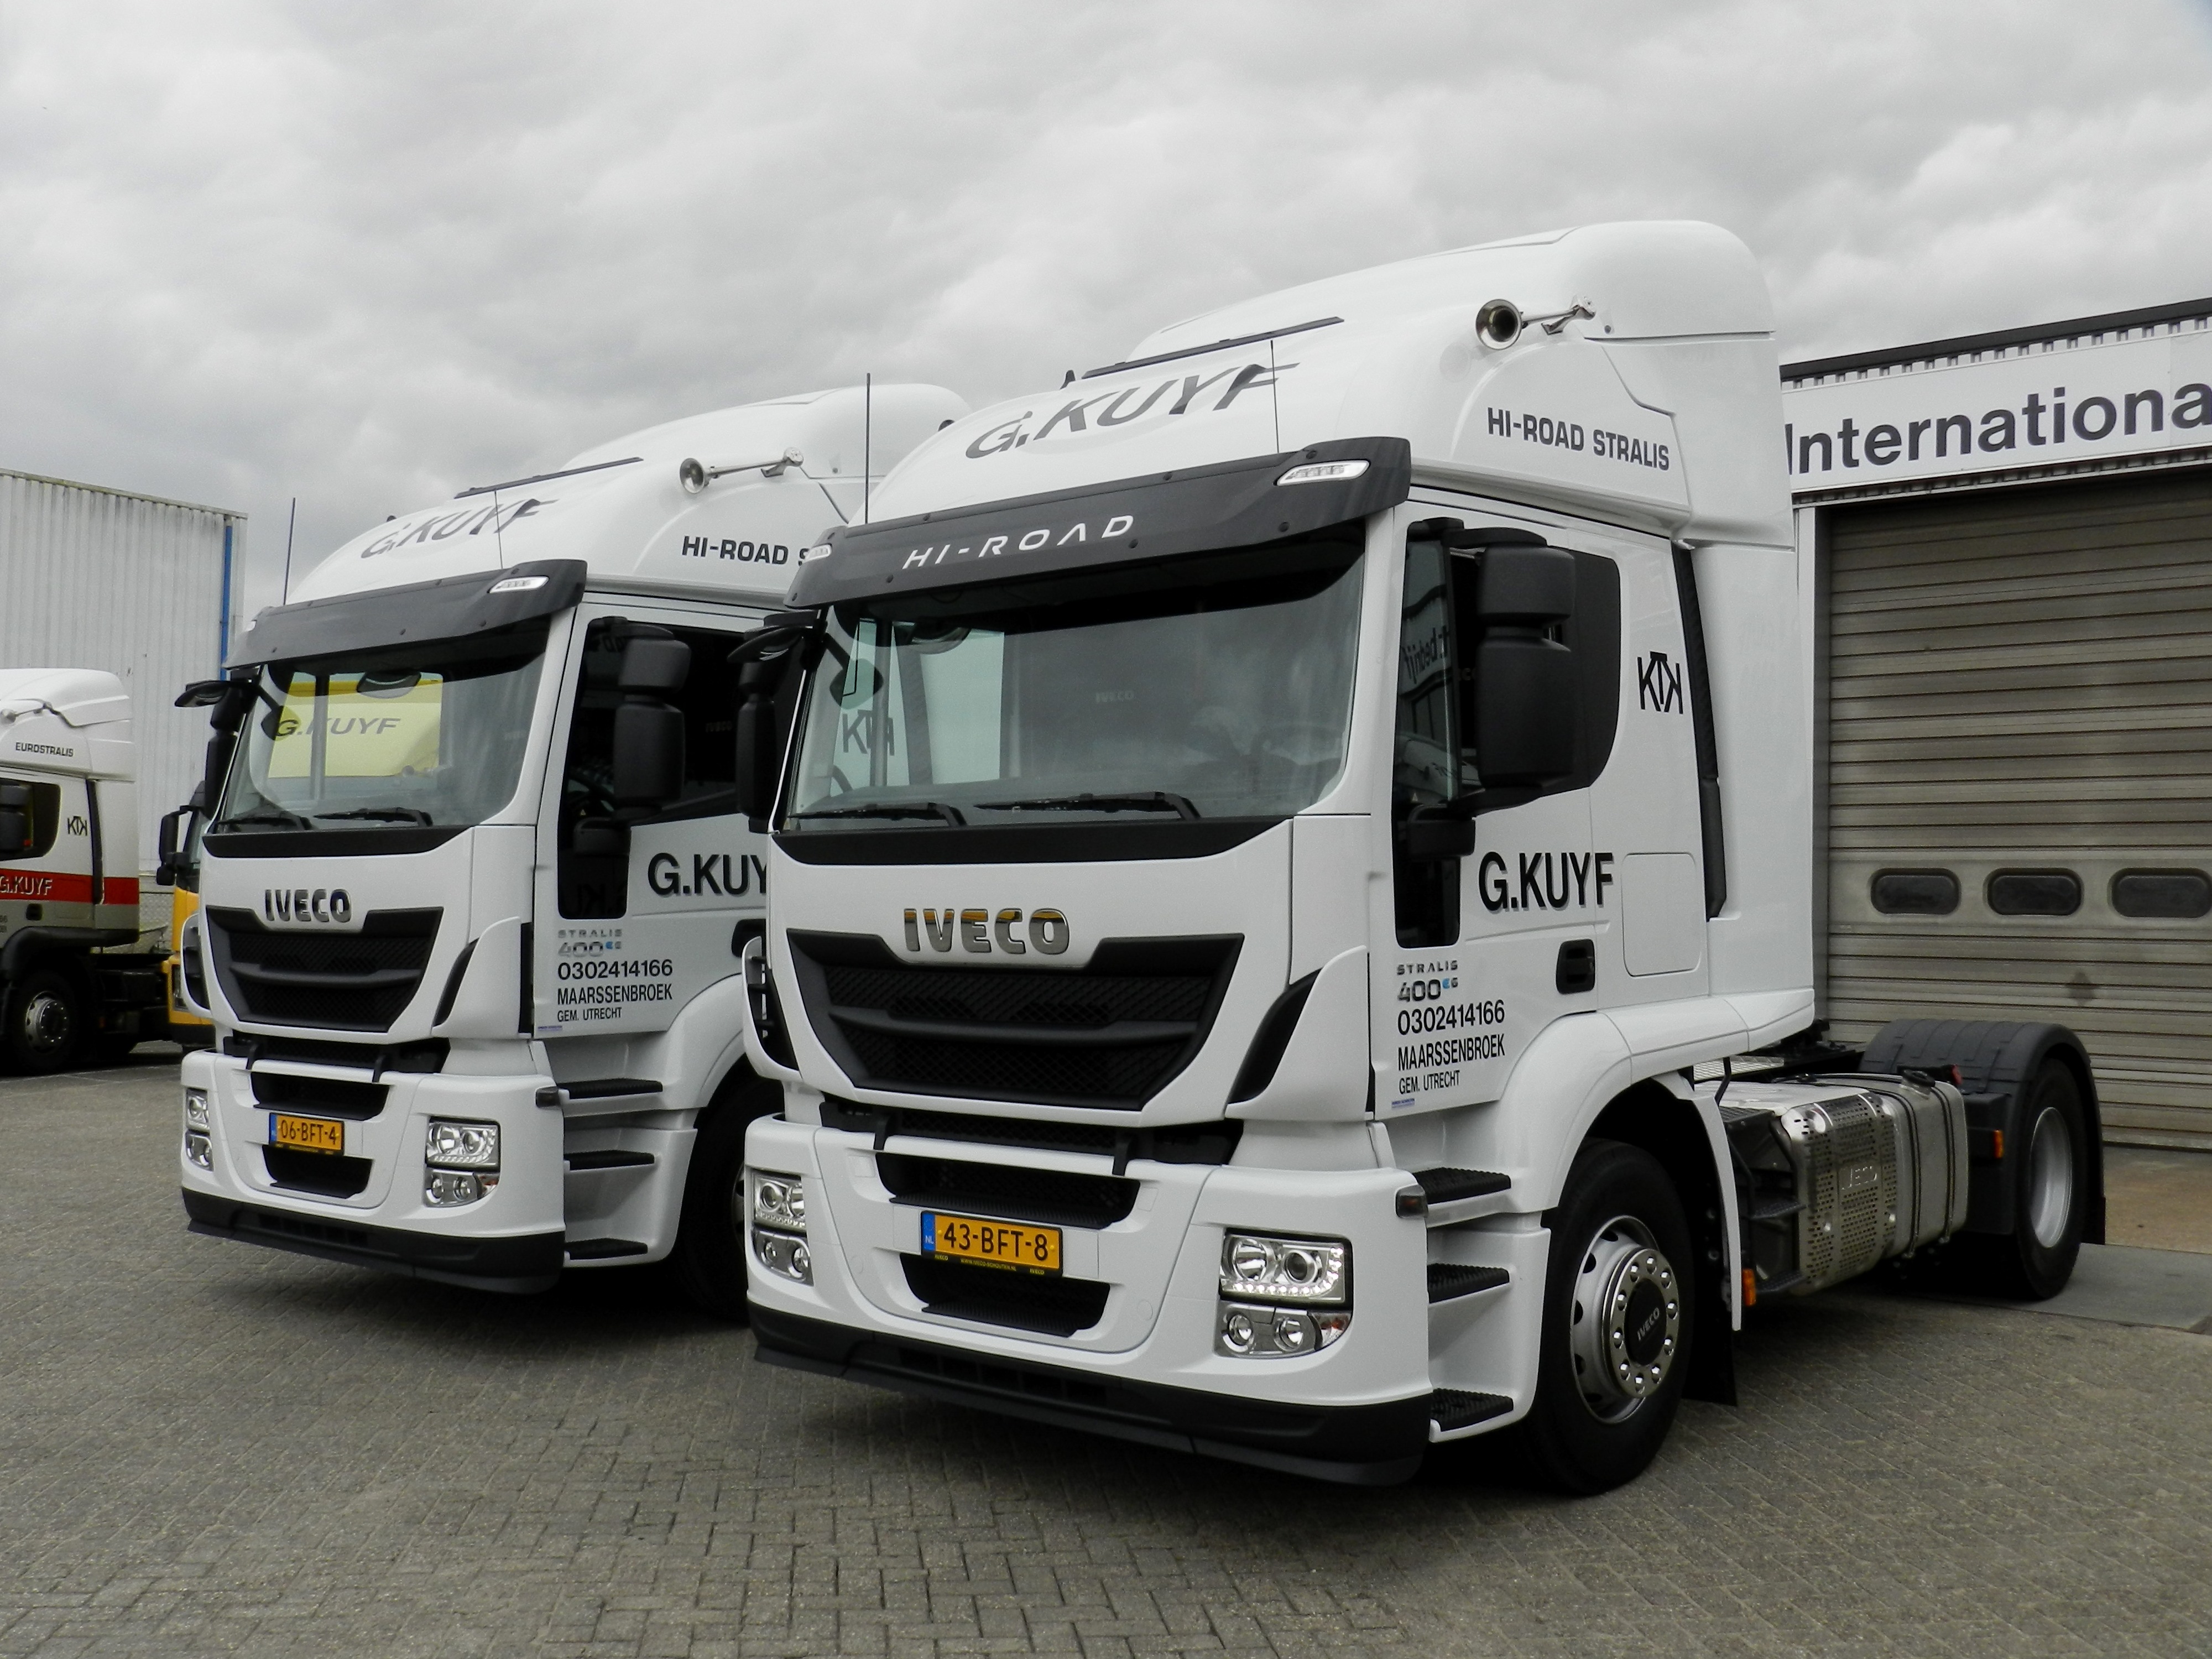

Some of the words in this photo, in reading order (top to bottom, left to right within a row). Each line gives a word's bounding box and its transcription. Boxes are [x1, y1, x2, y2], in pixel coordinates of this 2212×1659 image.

[966, 363, 1300, 458] G.KUYF
[1488, 407, 1585, 451] HI-ROAD
[1593, 430, 1670, 471] STRALIS
[361, 499, 559, 558] G.KUYF
[682, 536, 789, 565] HI-ROAD
[902, 515, 1134, 569] HI-ROAD
[276, 718, 400, 737] G.UYF
[15, 742, 74, 757] EUROSTRALIS
[0, 876, 53, 895] G.KUYF
[1478, 852, 1614, 912] G.KUYF
[265, 889, 352, 922] IVECO
[558, 929, 622, 938] STRALIS
[904, 907, 1070, 955] IVECO
[558, 942, 603, 957] 400
[558, 959, 672, 980] 0302414166
[1397, 960, 1458, 975] STRALIS
[558, 984, 672, 1005] MAARSSENBROEK
[1397, 979, 1441, 1001] 400
[557, 1010, 579, 1022] GEM.
[583, 1007, 622, 1020] UTRECHT
[1397, 999, 1505, 1035] 0302414166
[1398, 1034, 1505, 1071] MAARSSENBROEK
[1399, 1077, 1420, 1094] GEM.
[1423, 1070, 1460, 1091] UTRECHT
[281, 1119, 337, 1145] 06-BFT-4
[925, 1235, 934, 1244] NL
[943, 1222, 1048, 1261] 43-BFT-8
[1637, 1307, 1660, 1341] IVECO
